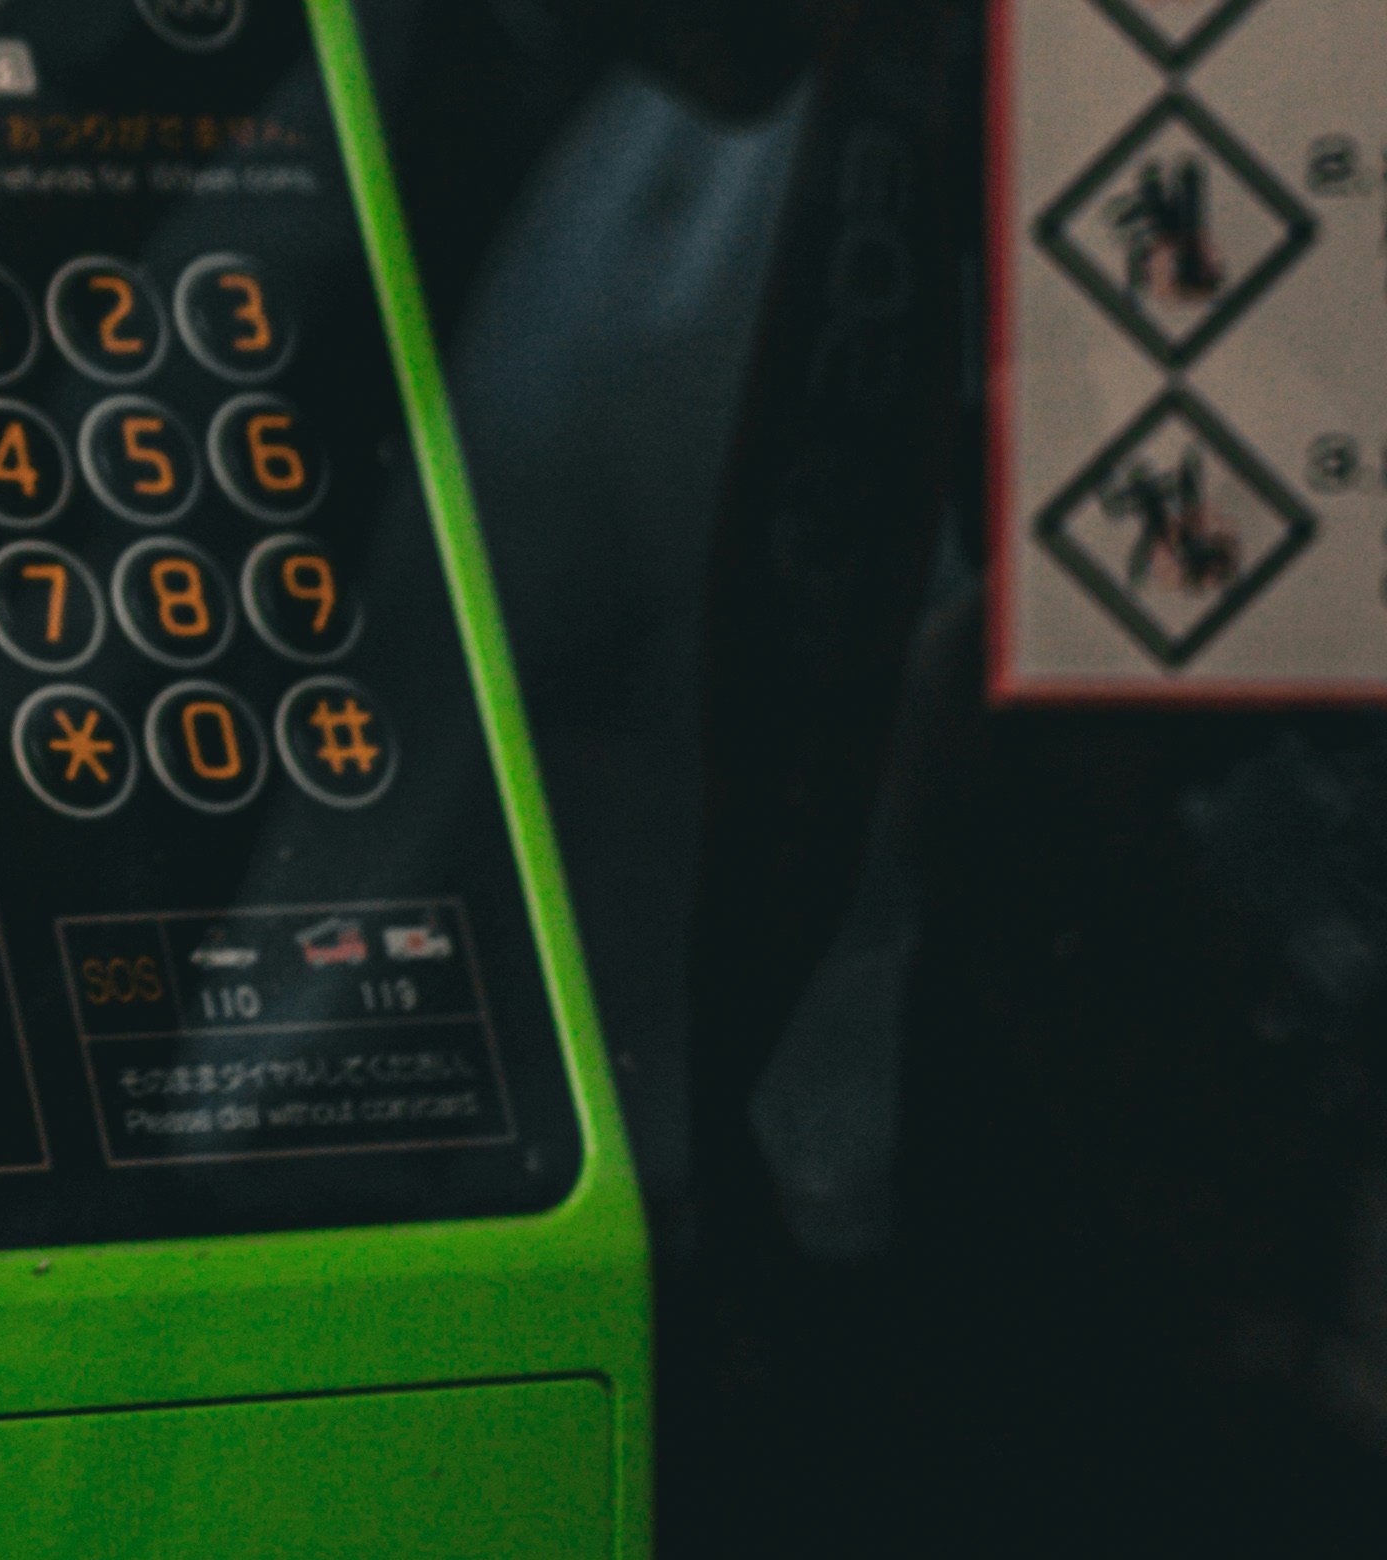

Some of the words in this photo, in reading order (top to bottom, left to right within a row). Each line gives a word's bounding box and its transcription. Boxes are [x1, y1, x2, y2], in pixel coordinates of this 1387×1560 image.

[90, 276, 143, 354] 2
[220, 275, 272, 352] 3
[122, 418, 175, 495] 5
[246, 414, 306, 493] 6
[23, 564, 67, 643] 7
[150, 559, 211, 636] 8
[282, 555, 336, 634] 9
[182, 701, 243, 780] 0
[82, 955, 165, 1006] SOS
[200, 983, 261, 1019] 110
[360, 976, 419, 1012] 119
[124, 1107, 213, 1136] Please
